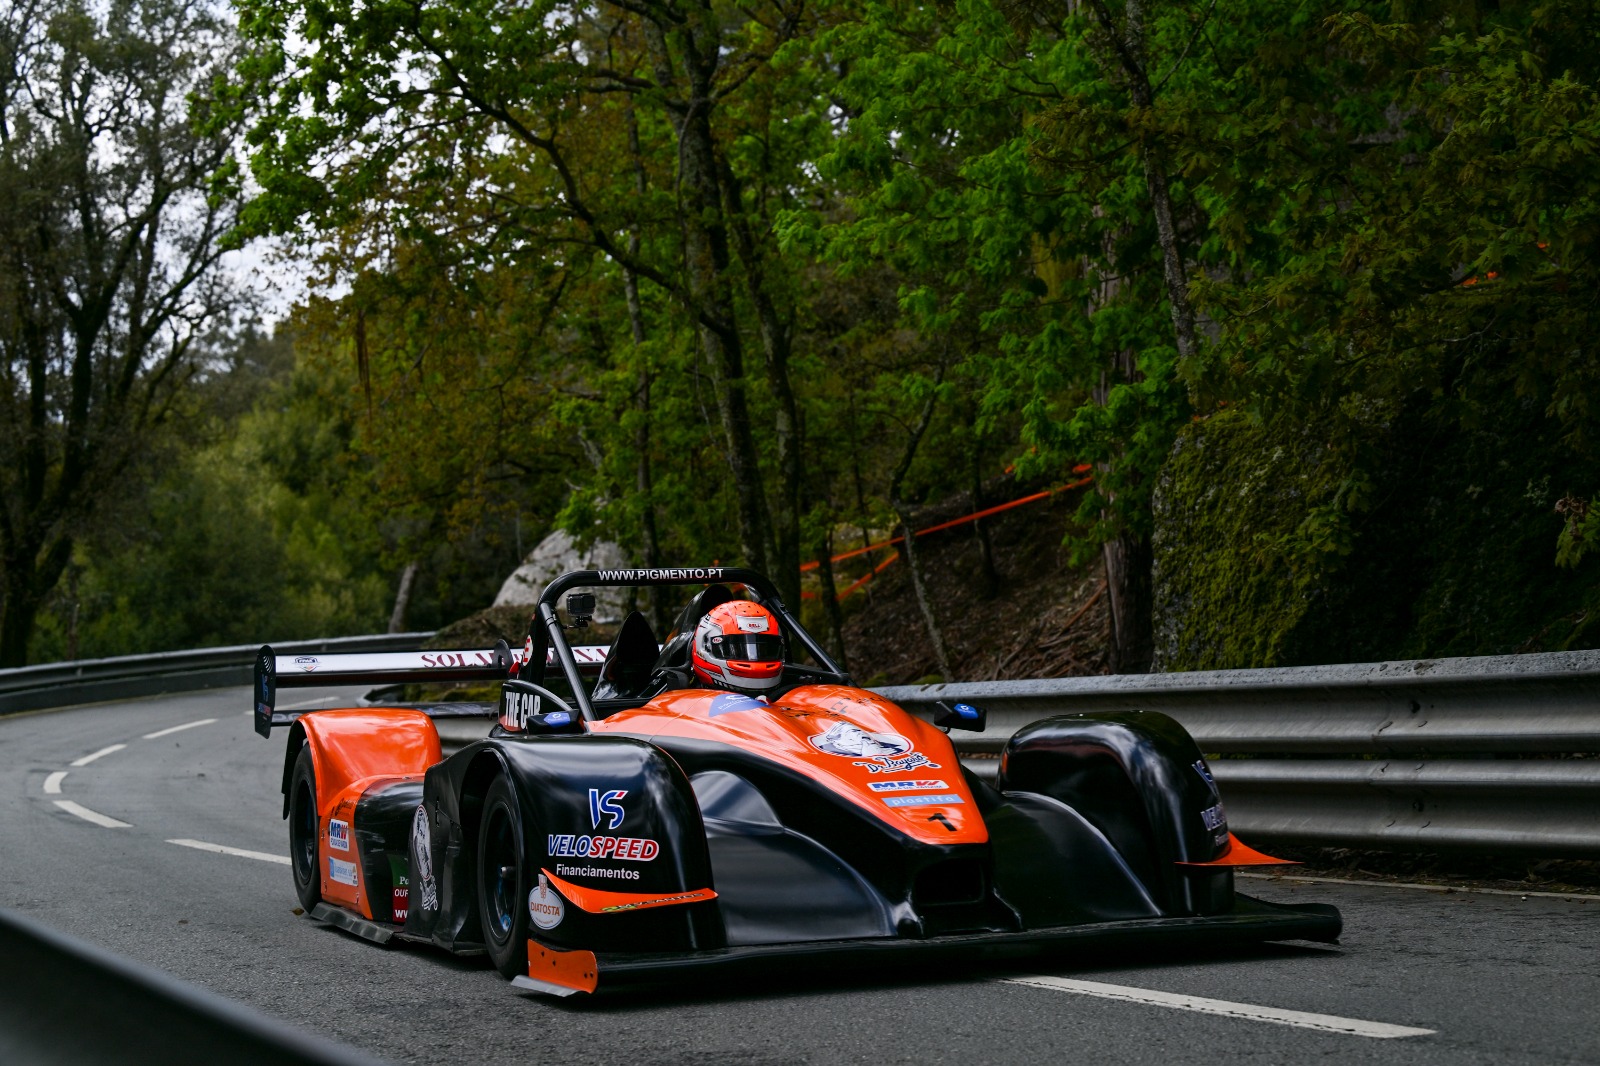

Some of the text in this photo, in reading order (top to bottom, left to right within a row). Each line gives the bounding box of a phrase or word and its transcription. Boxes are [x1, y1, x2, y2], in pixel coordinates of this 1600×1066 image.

[598, 568, 723, 581] WWW.PIGMENTO.PT
[505, 691, 520, 728] THE
[872, 781, 940, 789] MRW
[548, 834, 660, 862] VELOSPEED
[556, 863, 640, 880] Financiamentos
[530, 901, 560, 917] DIATOSTA
